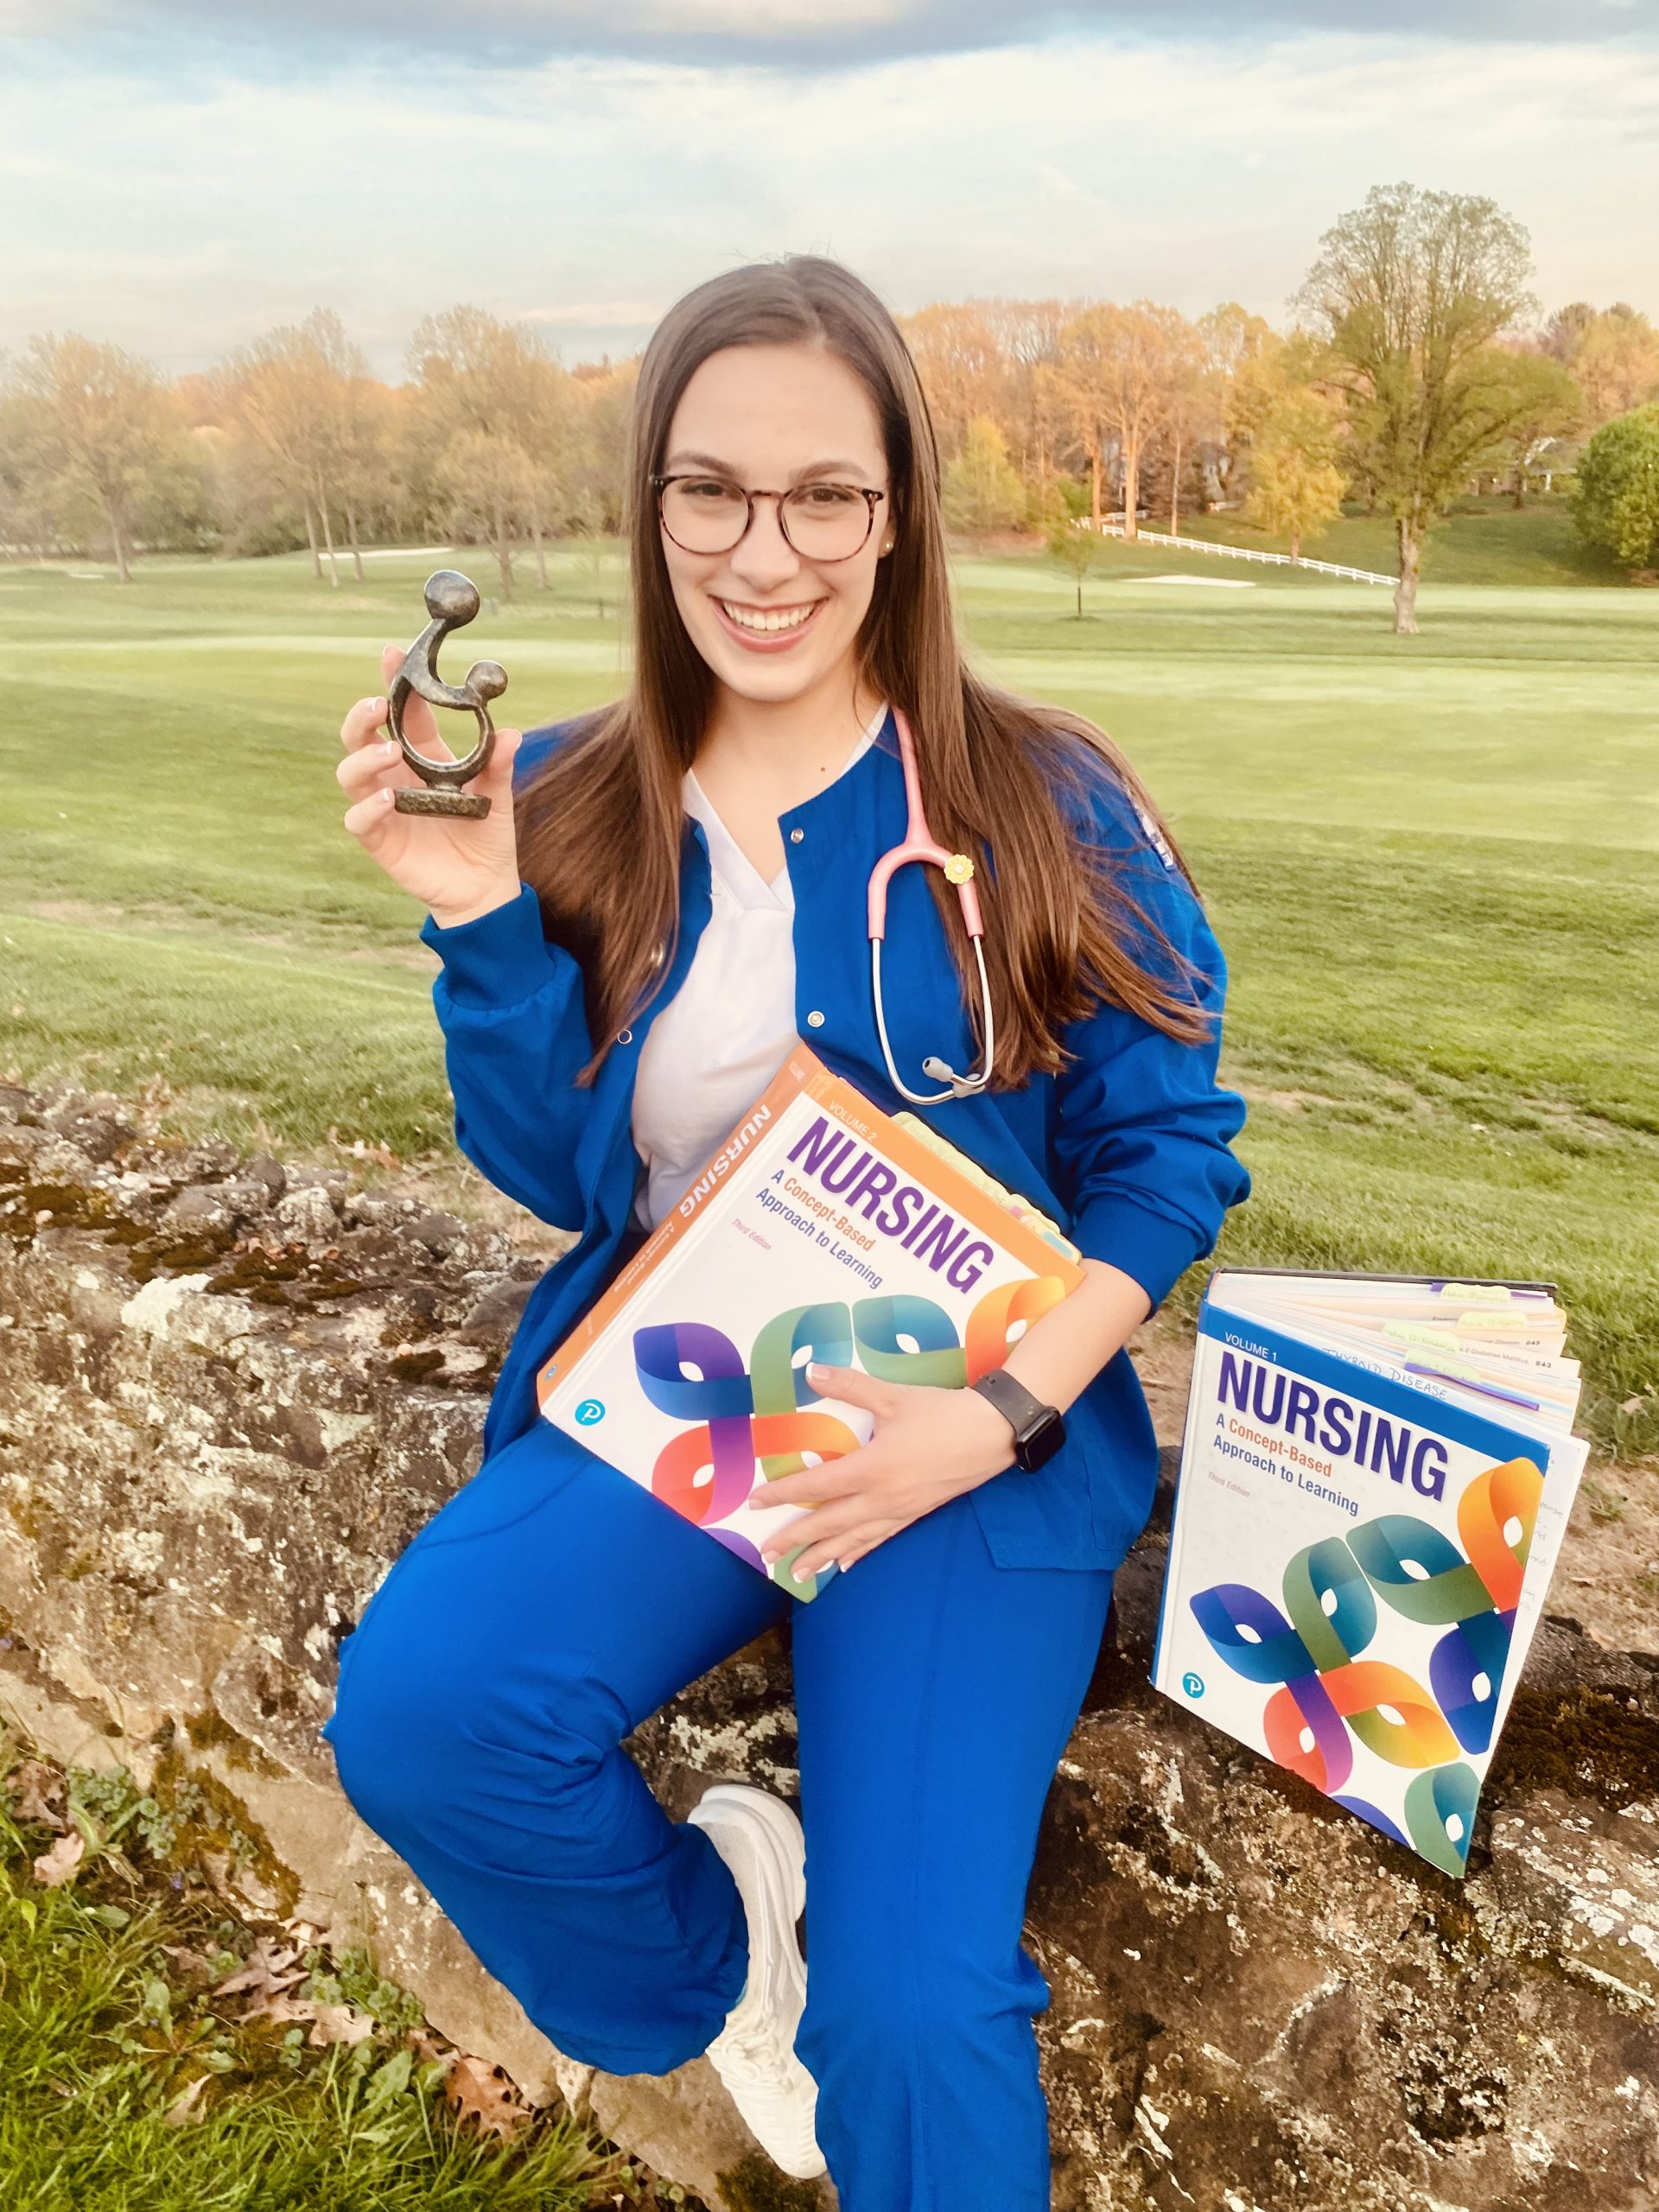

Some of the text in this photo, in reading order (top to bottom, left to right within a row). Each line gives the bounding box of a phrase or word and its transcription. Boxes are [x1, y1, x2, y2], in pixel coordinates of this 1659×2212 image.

[829, 1101, 877, 1141] VOLUME 2
[679, 1104, 772, 1217] NURSING
[733, 1218, 772, 1250] Third Edition
[771, 1169, 876, 1251] A Concept-Based
[786, 1116, 994, 1294] NURSING
[756, 1188, 883, 1290] Approach to Learning
[1224, 1332, 1277, 1362] VOLUME 1
[1535, 1360, 1552, 1369] 843
[1389, 1367, 1448, 1400] DISEASE
[1216, 1413, 1332, 1478] A Concept-Based
[1217, 1351, 1449, 1502] NURSING
[1209, 1471, 1250, 1497] Third Edition
[1213, 1434, 1359, 1517] Approach to Learning
